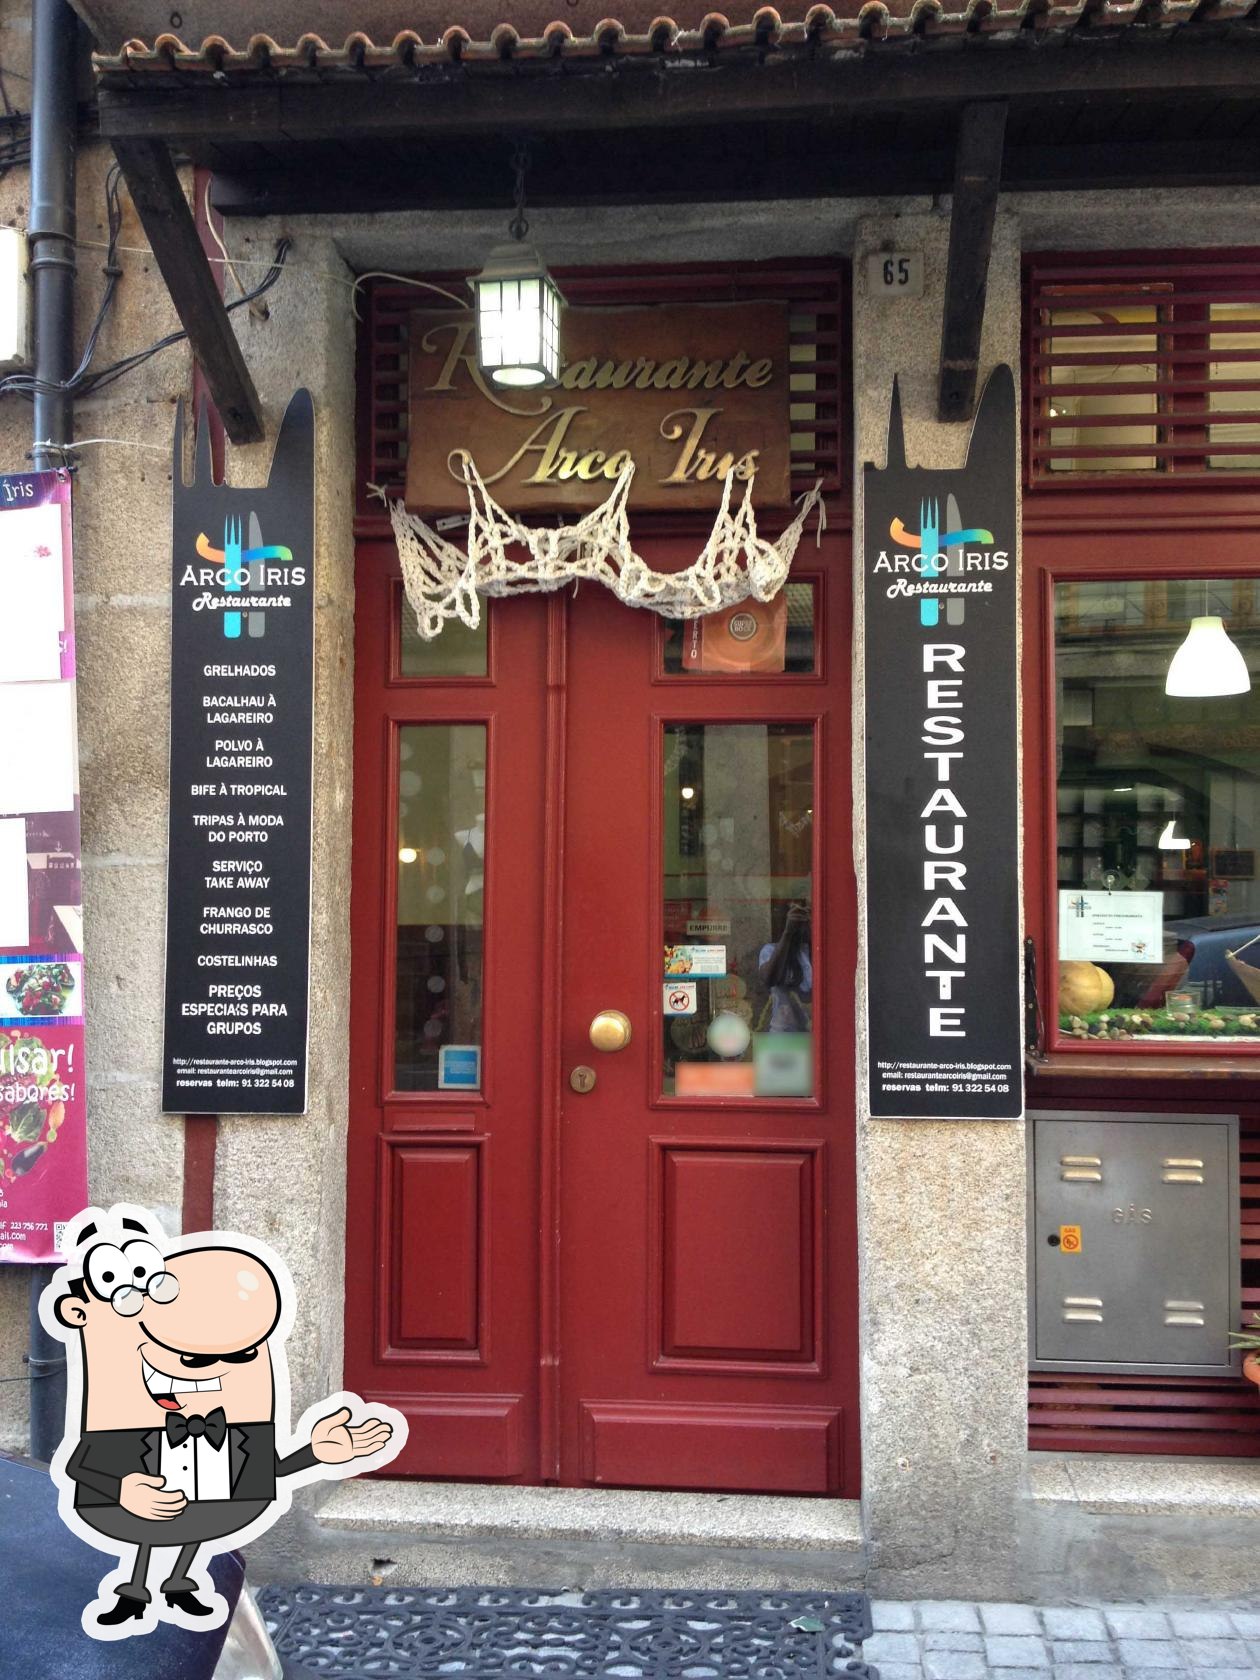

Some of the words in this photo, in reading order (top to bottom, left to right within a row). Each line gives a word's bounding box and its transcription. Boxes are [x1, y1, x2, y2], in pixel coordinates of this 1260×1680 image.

[883, 258, 910, 285] 65
[422, 321, 774, 416] Raurante
[447, 405, 633, 488] Arco
[3, 479, 34, 502] Íris
[873, 551, 949, 573] ARCO
[958, 549, 1009, 571] IRIS
[180, 564, 251, 586] ARCO
[259, 564, 306, 586] IRIS
[887, 578, 993, 599] Restaurante
[191, 592, 292, 611] Restaurante
[203, 664, 276, 677] GRELHADOS
[203, 696, 265, 707] BACALHAU
[267, 693, 277, 707] À
[207, 712, 274, 724] LAGAREIRO
[215, 739, 253, 752] POLVO
[255, 737, 264, 752] À
[206, 756, 273, 768] LAGAREIRO
[191, 784, 217, 796] BIFE
[219, 782, 228, 796] À
[230, 784, 287, 796] TROPICAL
[193, 814, 235, 826] TRIPAS
[237, 812, 246, 826] À
[248, 814, 284, 826] MODA
[208, 830, 226, 843] DO
[228, 831, 269, 843] PORTO
[920, 643, 969, 1037] RESTAURANTE
[212, 860, 263, 875] SERVIÇO
[204, 876, 234, 889] TAKE
[236, 876, 271, 889] AWAY
[203, 906, 252, 919] FRANGO
[254, 906, 271, 919] DE
[200, 923, 274, 935] CHURRASCO
[197, 955, 278, 967] COSTELINHAS
[208, 984, 262, 1001] PREÇOS
[181, 1003, 249, 1016] ESPECIAIS
[252, 1003, 288, 1017] PARA
[207, 1021, 262, 1035] GRUPOS
[176, 1067, 197, 1075] email:
[877, 1061, 1012, 1071] http://restaurante-arco-iris.blogspot.com
[881, 1071, 904, 1079] email:
[176, 1079, 213, 1087] reservas
[216, 1078, 240, 1087] telm:
[241, 1079, 253, 1088] 91
[253, 1079, 270, 1088] 322
[271, 1079, 282, 1088] 54
[282, 1079, 295, 1088] 08
[881, 1083, 922, 1092] reservas
[925, 1082, 950, 1092] telm:
[951, 1083, 964, 1093] 91
[965, 1084, 983, 1093] 322
[984, 1083, 998, 1093] 54
[997, 1084, 1010, 1093] 08
